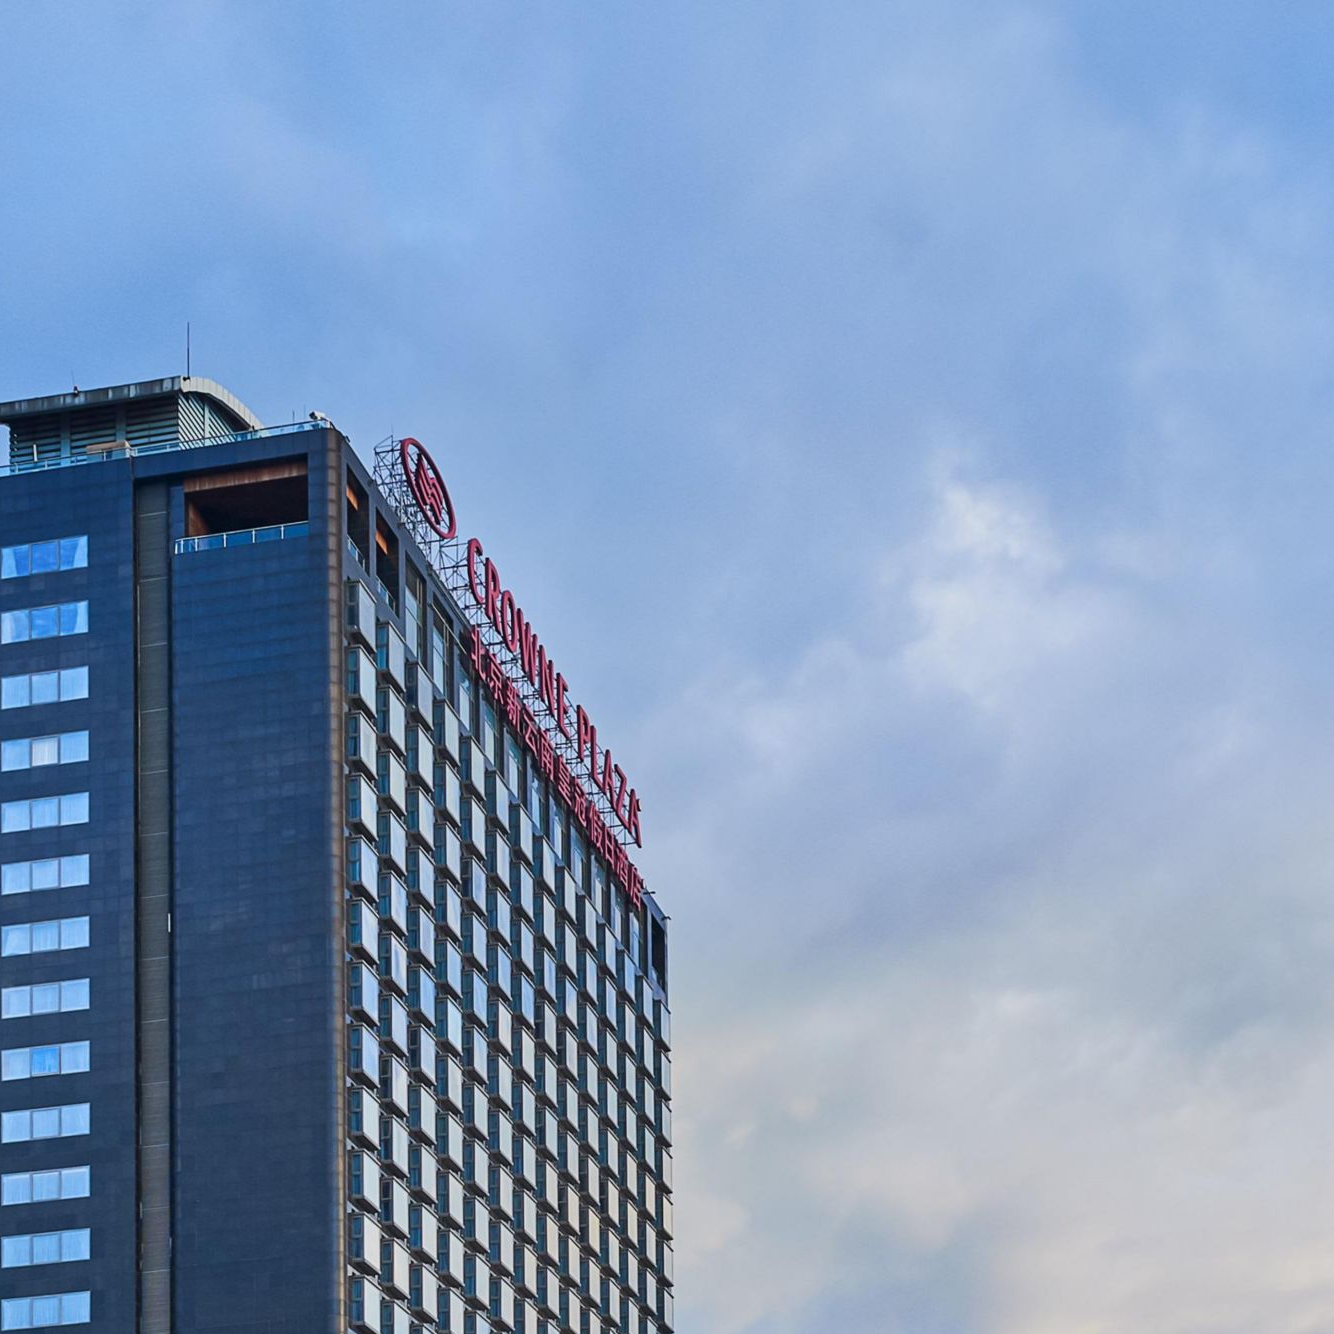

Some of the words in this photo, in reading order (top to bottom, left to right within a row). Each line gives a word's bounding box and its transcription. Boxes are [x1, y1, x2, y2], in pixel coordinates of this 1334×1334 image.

[467, 537, 569, 739] CROWNE
[576, 704, 642, 848] PLAZA
[470, 625, 642, 911] 北京新云南皇冠假日酒店
